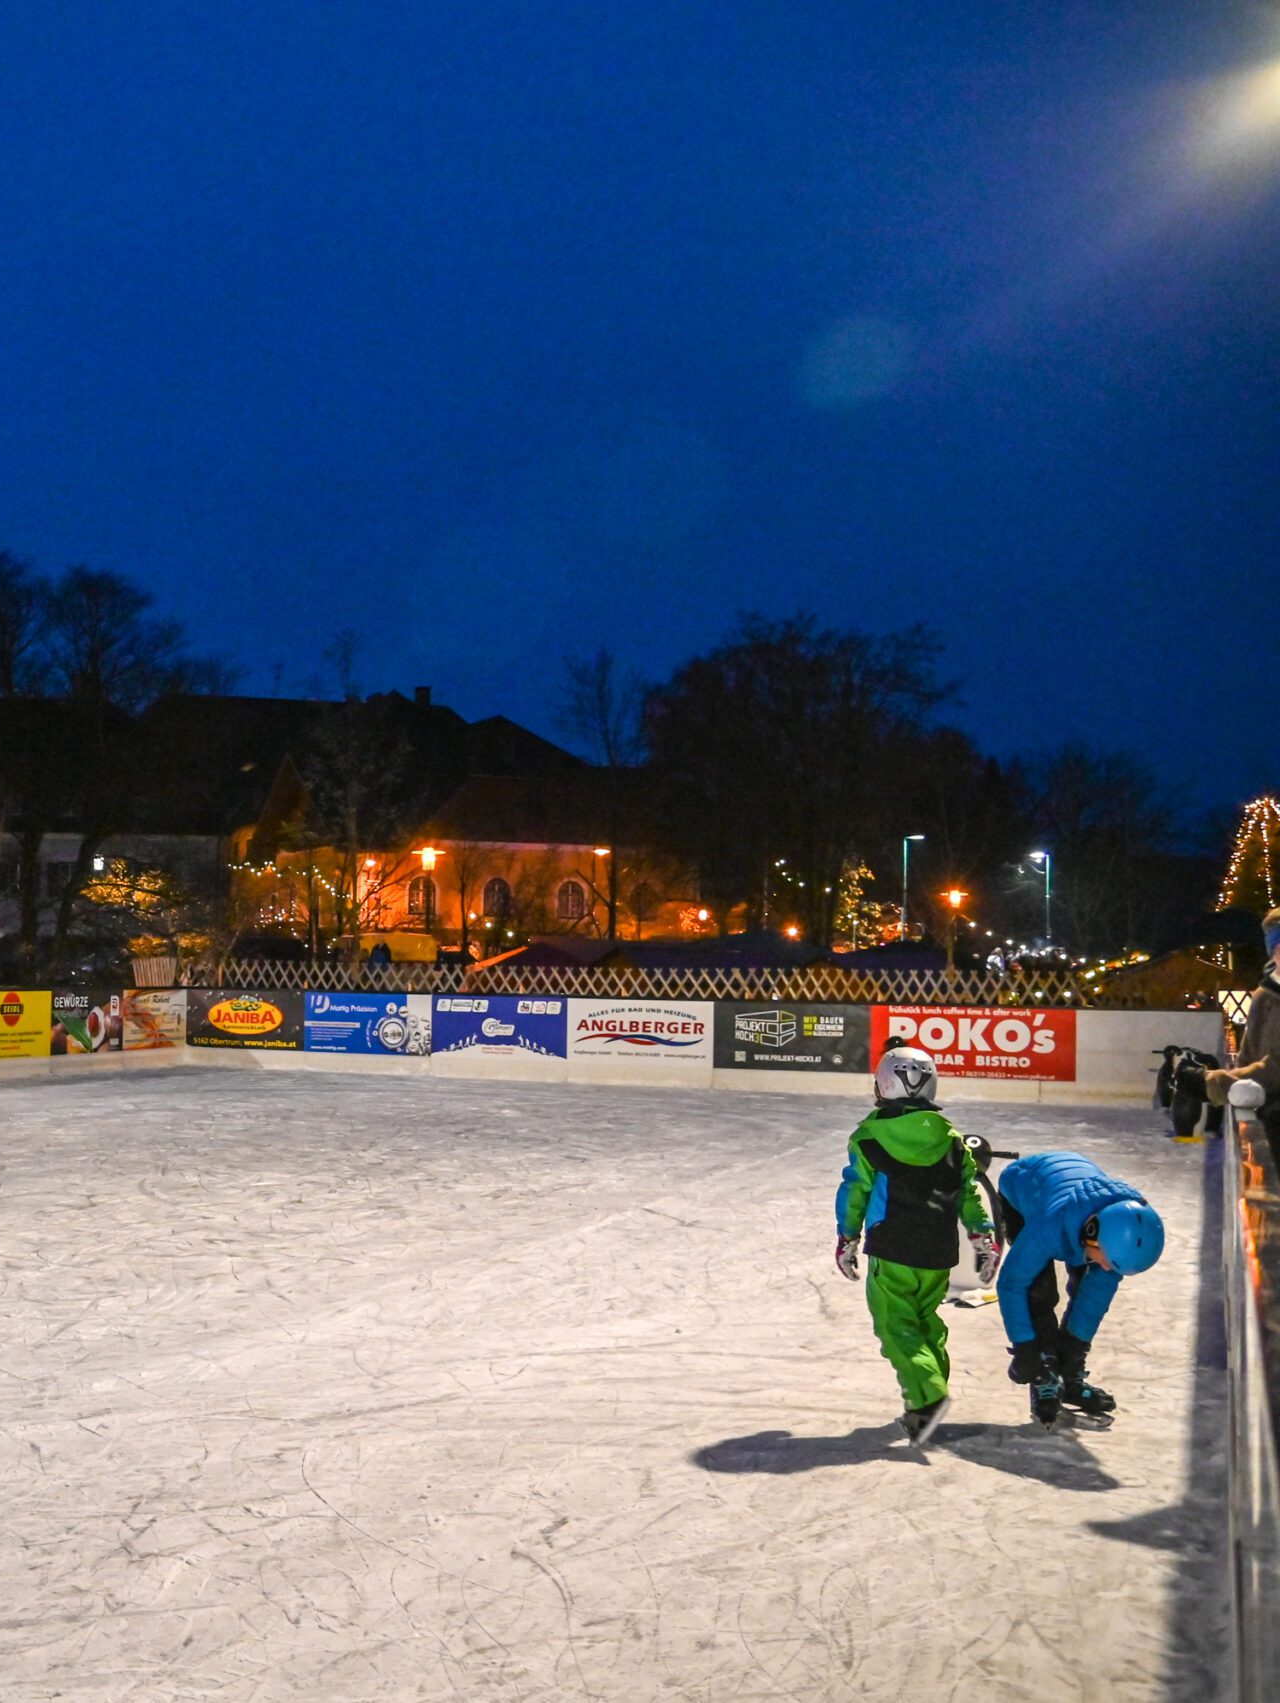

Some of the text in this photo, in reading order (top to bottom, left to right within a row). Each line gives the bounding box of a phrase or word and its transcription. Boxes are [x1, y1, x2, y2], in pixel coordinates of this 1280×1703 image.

[54, 994, 89, 1008] GEWÜRZE
[2, 1005, 21, 1013] SEIDL
[588, 1009, 609, 1018] ALLES
[664, 1009, 697, 1021] HEIZUNG
[889, 1005, 921, 1014] frühstück
[922, 1006, 942, 1014] lunch
[943, 1007, 966, 1015] coffee
[967, 1007, 983, 1015] time
[993, 1008, 1010, 1016] after
[213, 1008, 277, 1025] JANIBA
[803, 1016, 818, 1024] WIR
[576, 1019, 705, 1035] ANGLBERGER
[735, 1020, 766, 1033] PROJEKT
[735, 1030, 760, 1043] HOCH3
[889, 1013, 1056, 1054] POKO's
[193, 1037, 209, 1045] 5162
[244, 1040, 297, 1048] www.janiba.at
[754, 1053, 822, 1063] WWW.PROJEKT-HOCH3.AT
[934, 1053, 1031, 1068] BAR BISTRO
